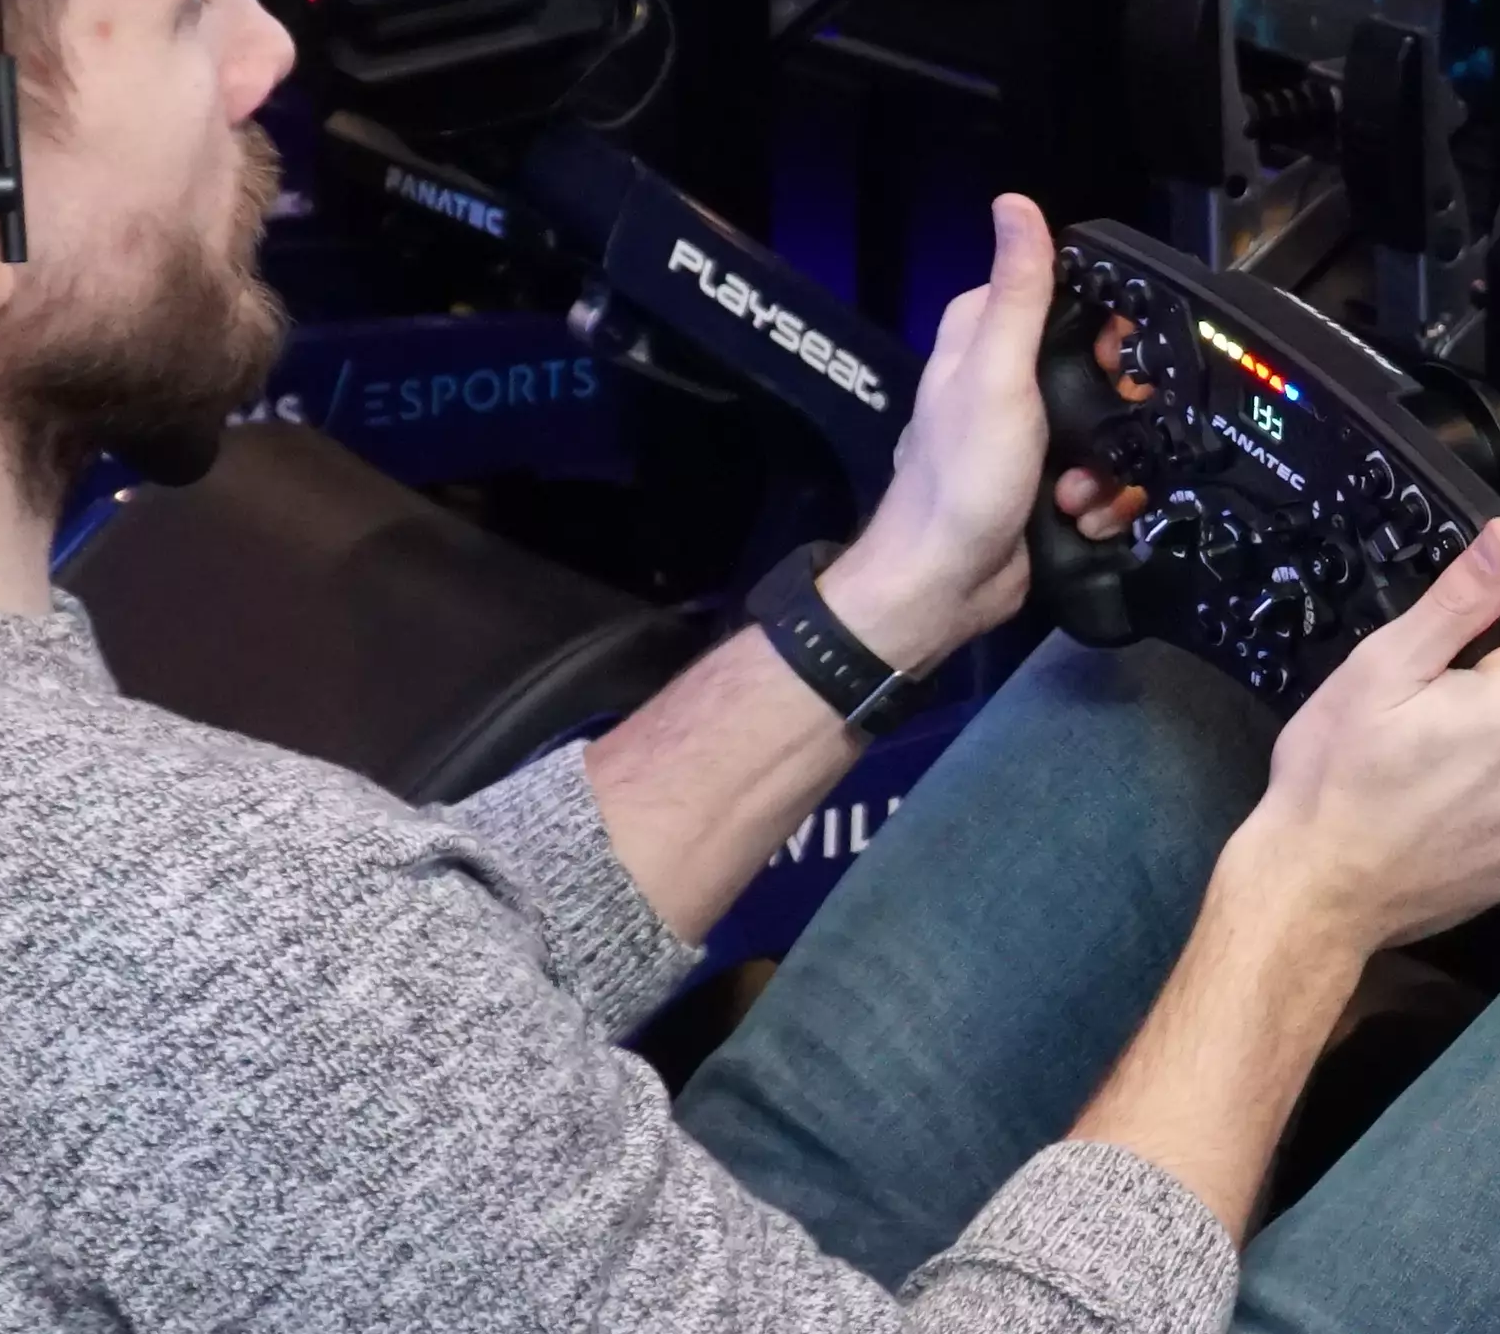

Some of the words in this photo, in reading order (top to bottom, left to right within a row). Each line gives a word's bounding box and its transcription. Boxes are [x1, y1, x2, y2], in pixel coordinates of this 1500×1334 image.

[385, 165, 509, 239] FANATEC
[364, 356, 599, 427] ESPORTS
[1211, 414, 1306, 492] FANATEC
